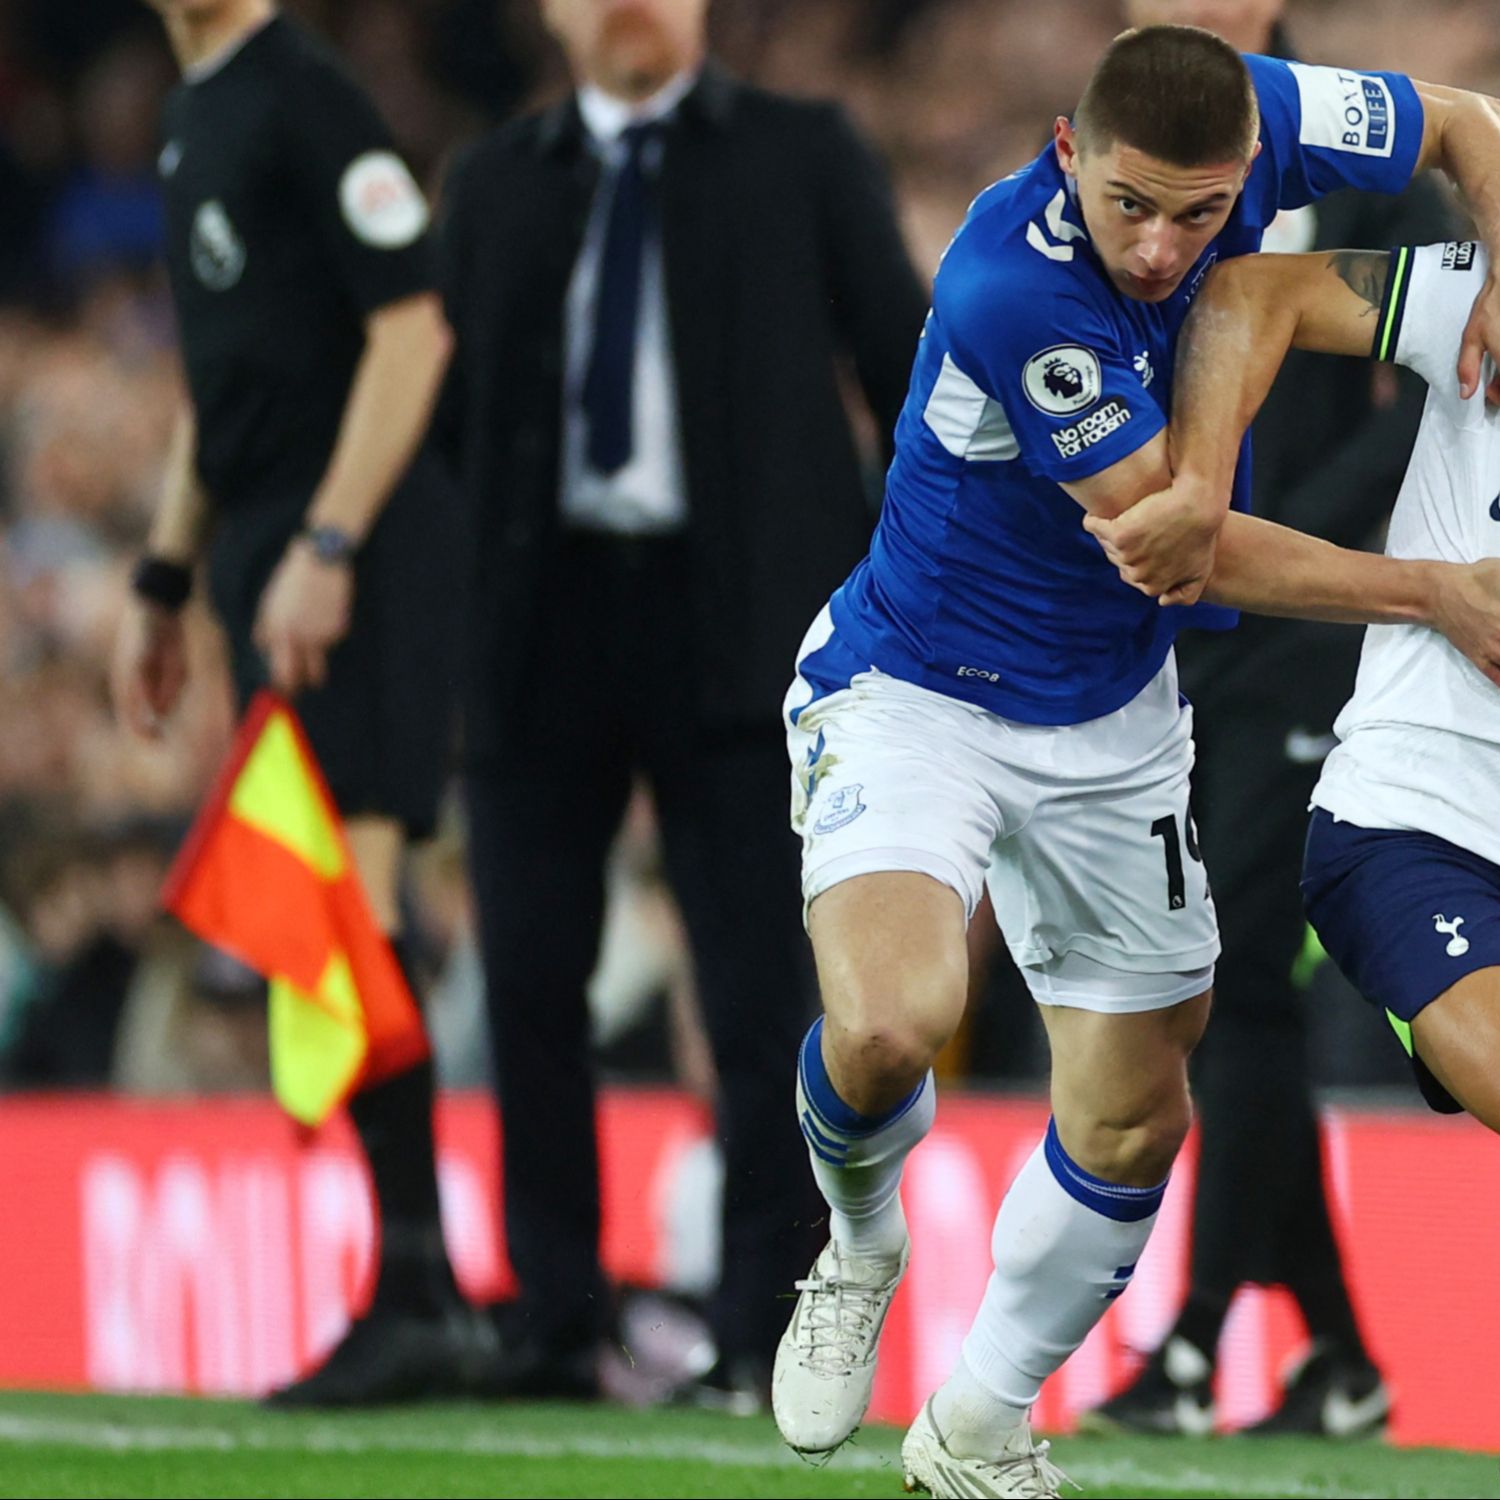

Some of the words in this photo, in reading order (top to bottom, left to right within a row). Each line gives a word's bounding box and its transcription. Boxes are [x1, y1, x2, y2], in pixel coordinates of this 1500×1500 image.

[1364, 87, 1387, 136] LIFE
[1051, 428, 1078, 447] No
[1077, 402, 1119, 434] room
[1060, 439, 1082, 459] for
[1081, 408, 1132, 447] racism
